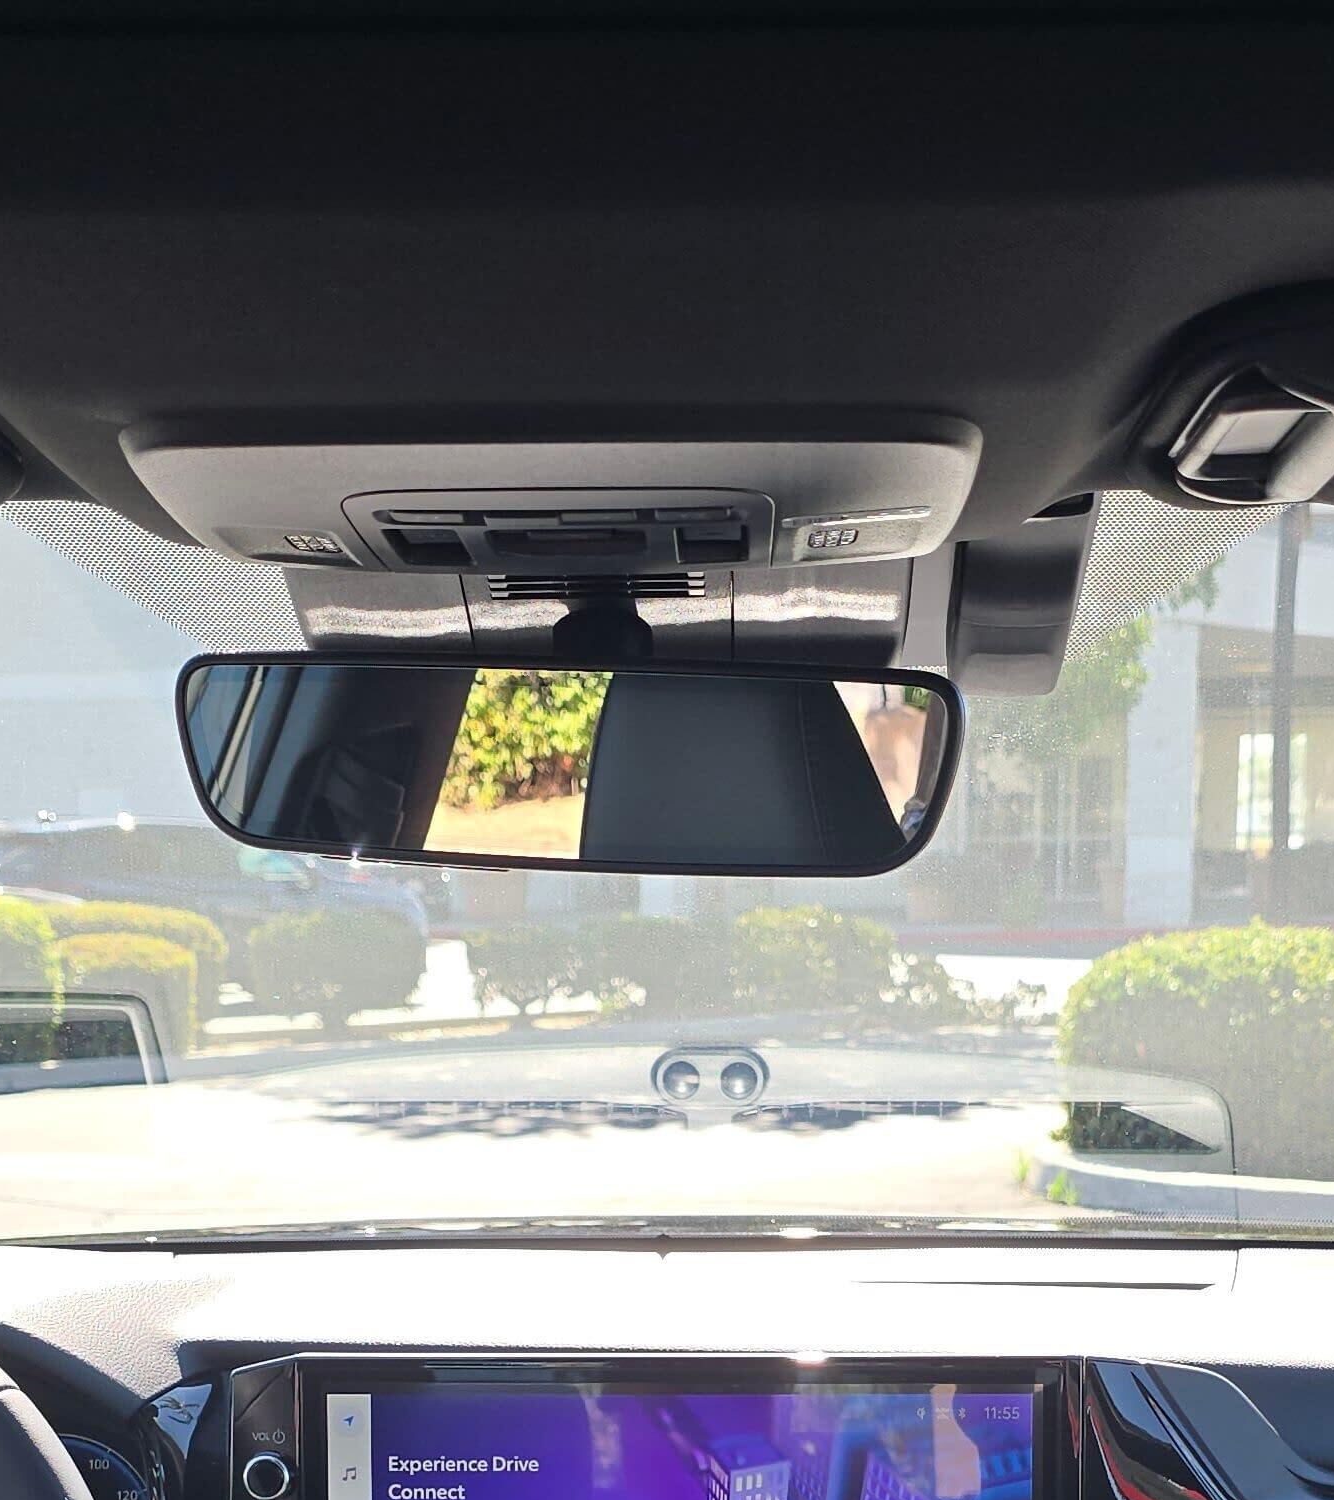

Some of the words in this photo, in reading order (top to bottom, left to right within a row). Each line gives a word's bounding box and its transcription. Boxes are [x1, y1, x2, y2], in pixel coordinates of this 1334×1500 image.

[984, 1407, 1019, 1419] 11:55
[252, 1432, 270, 1441] VOL
[89, 1459, 110, 1471] 100
[388, 1455, 488, 1475] Experience
[492, 1455, 539, 1472] Drive
[388, 1483, 466, 1500] Connect
